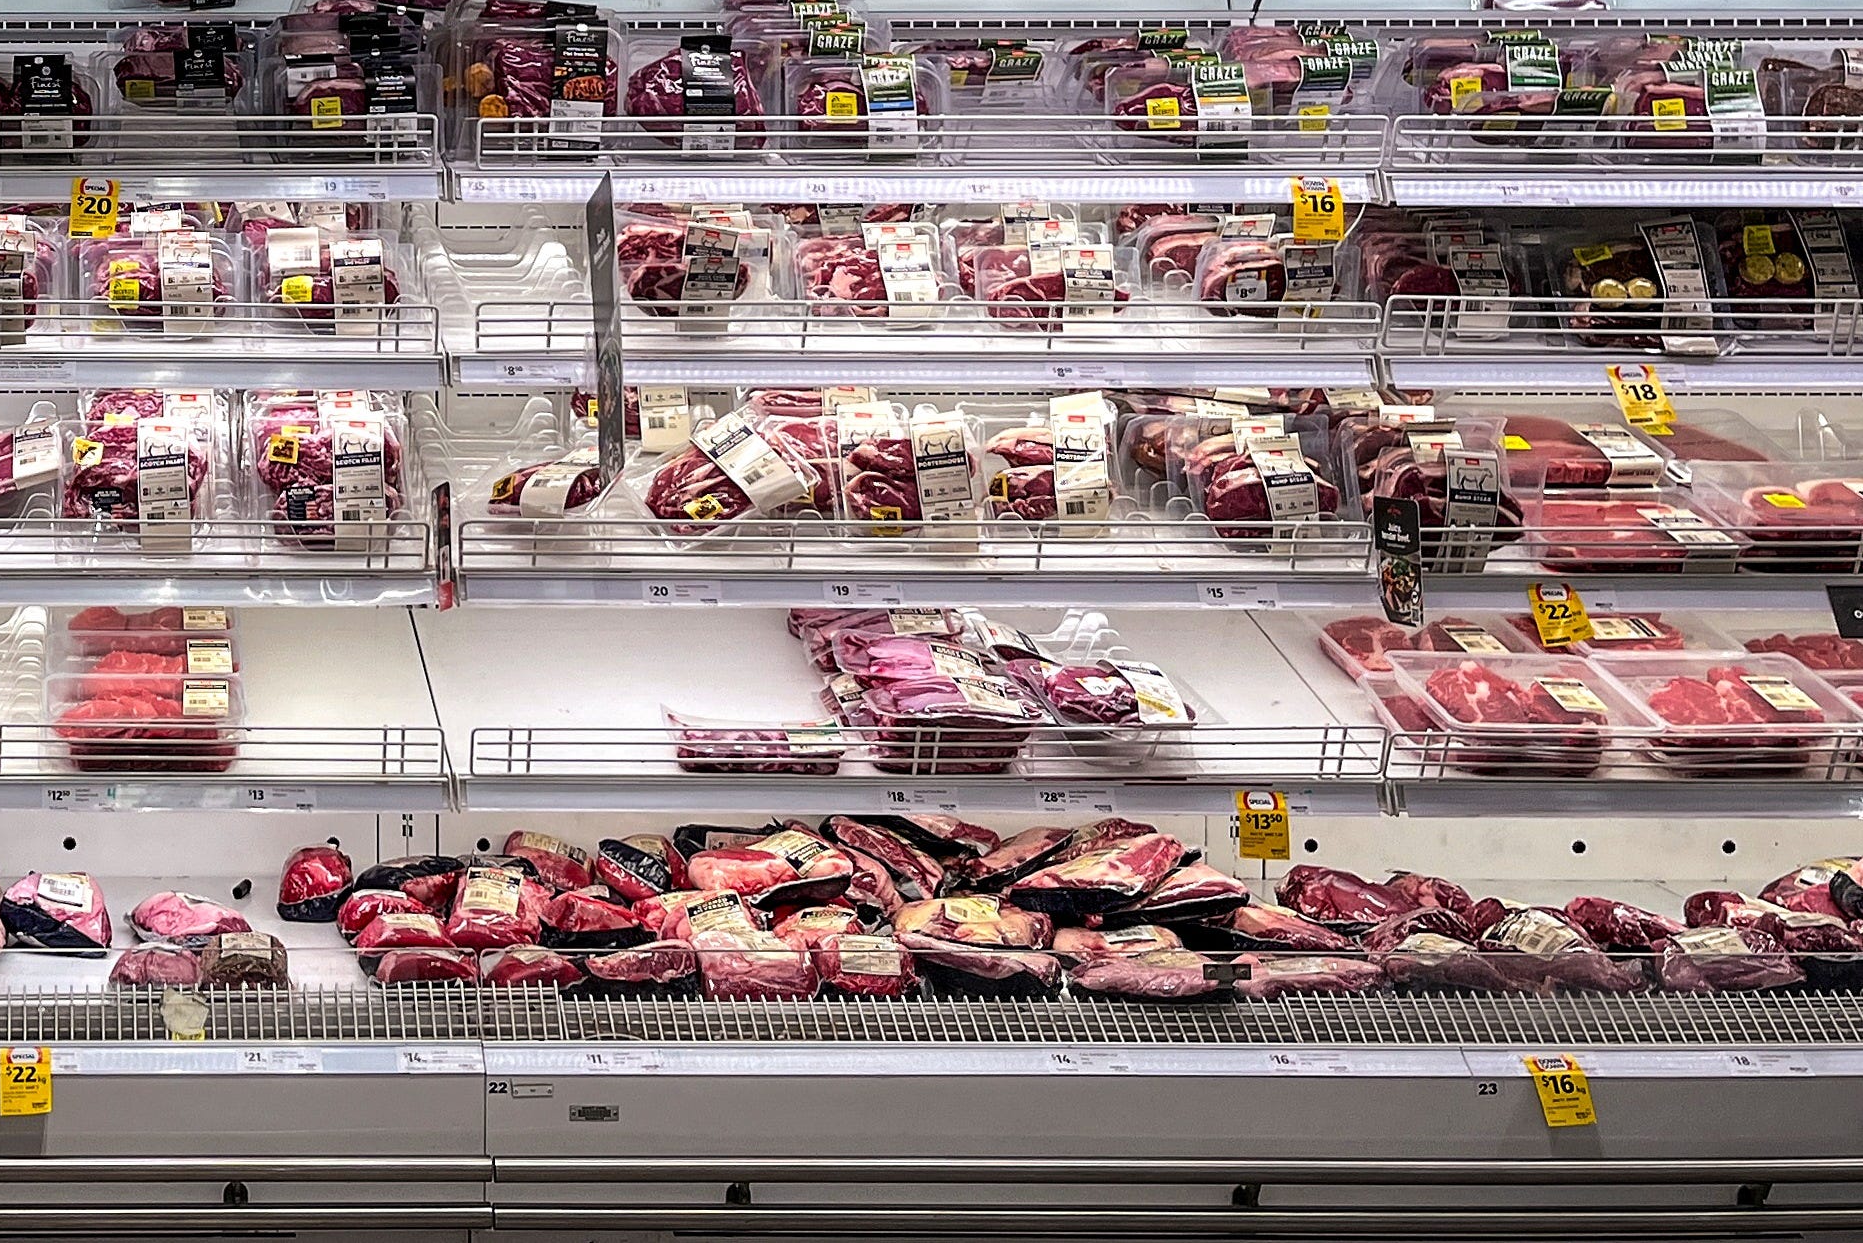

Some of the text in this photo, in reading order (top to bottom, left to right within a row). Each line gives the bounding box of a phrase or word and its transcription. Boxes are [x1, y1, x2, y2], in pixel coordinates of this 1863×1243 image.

[817, 34, 854, 49] GRAZE
[1335, 42, 1372, 55] GRAZE
[1513, 45, 1552, 60] GRAZE
[1308, 57, 1347, 71] GRAZE
[1199, 67, 1239, 81] GRAZE
[1711, 72, 1750, 86] GRAZE
[76, 195, 112, 214] $20
[1300, 193, 1335, 213] $16
[1621, 384, 1658, 401] $18
[140, 458, 185, 468] SCOTCH FILLET
[336, 457, 381, 467] SCOTCH FILLET
[917, 456, 965, 468] PORTERHOUSE
[648, 584, 669, 597] $20
[831, 584, 850, 597] $19
[1206, 587, 1224, 599] $15
[1538, 604, 1572, 620] $22
[248, 789, 265, 801] $13
[887, 791, 905, 803] $18
[1248, 798, 1271, 806] SPECIAL
[244, 1052, 261, 1063] $21
[403, 1052, 421, 1063] $14
[586, 1054, 602, 1064] $11
[1052, 1054, 1071, 1064] $14
[6, 1065, 47, 1085] $22 kg
[488, 1082, 508, 1095] 22
[1478, 1083, 1498, 1096] 23
[1542, 1074, 1575, 1095] $16
